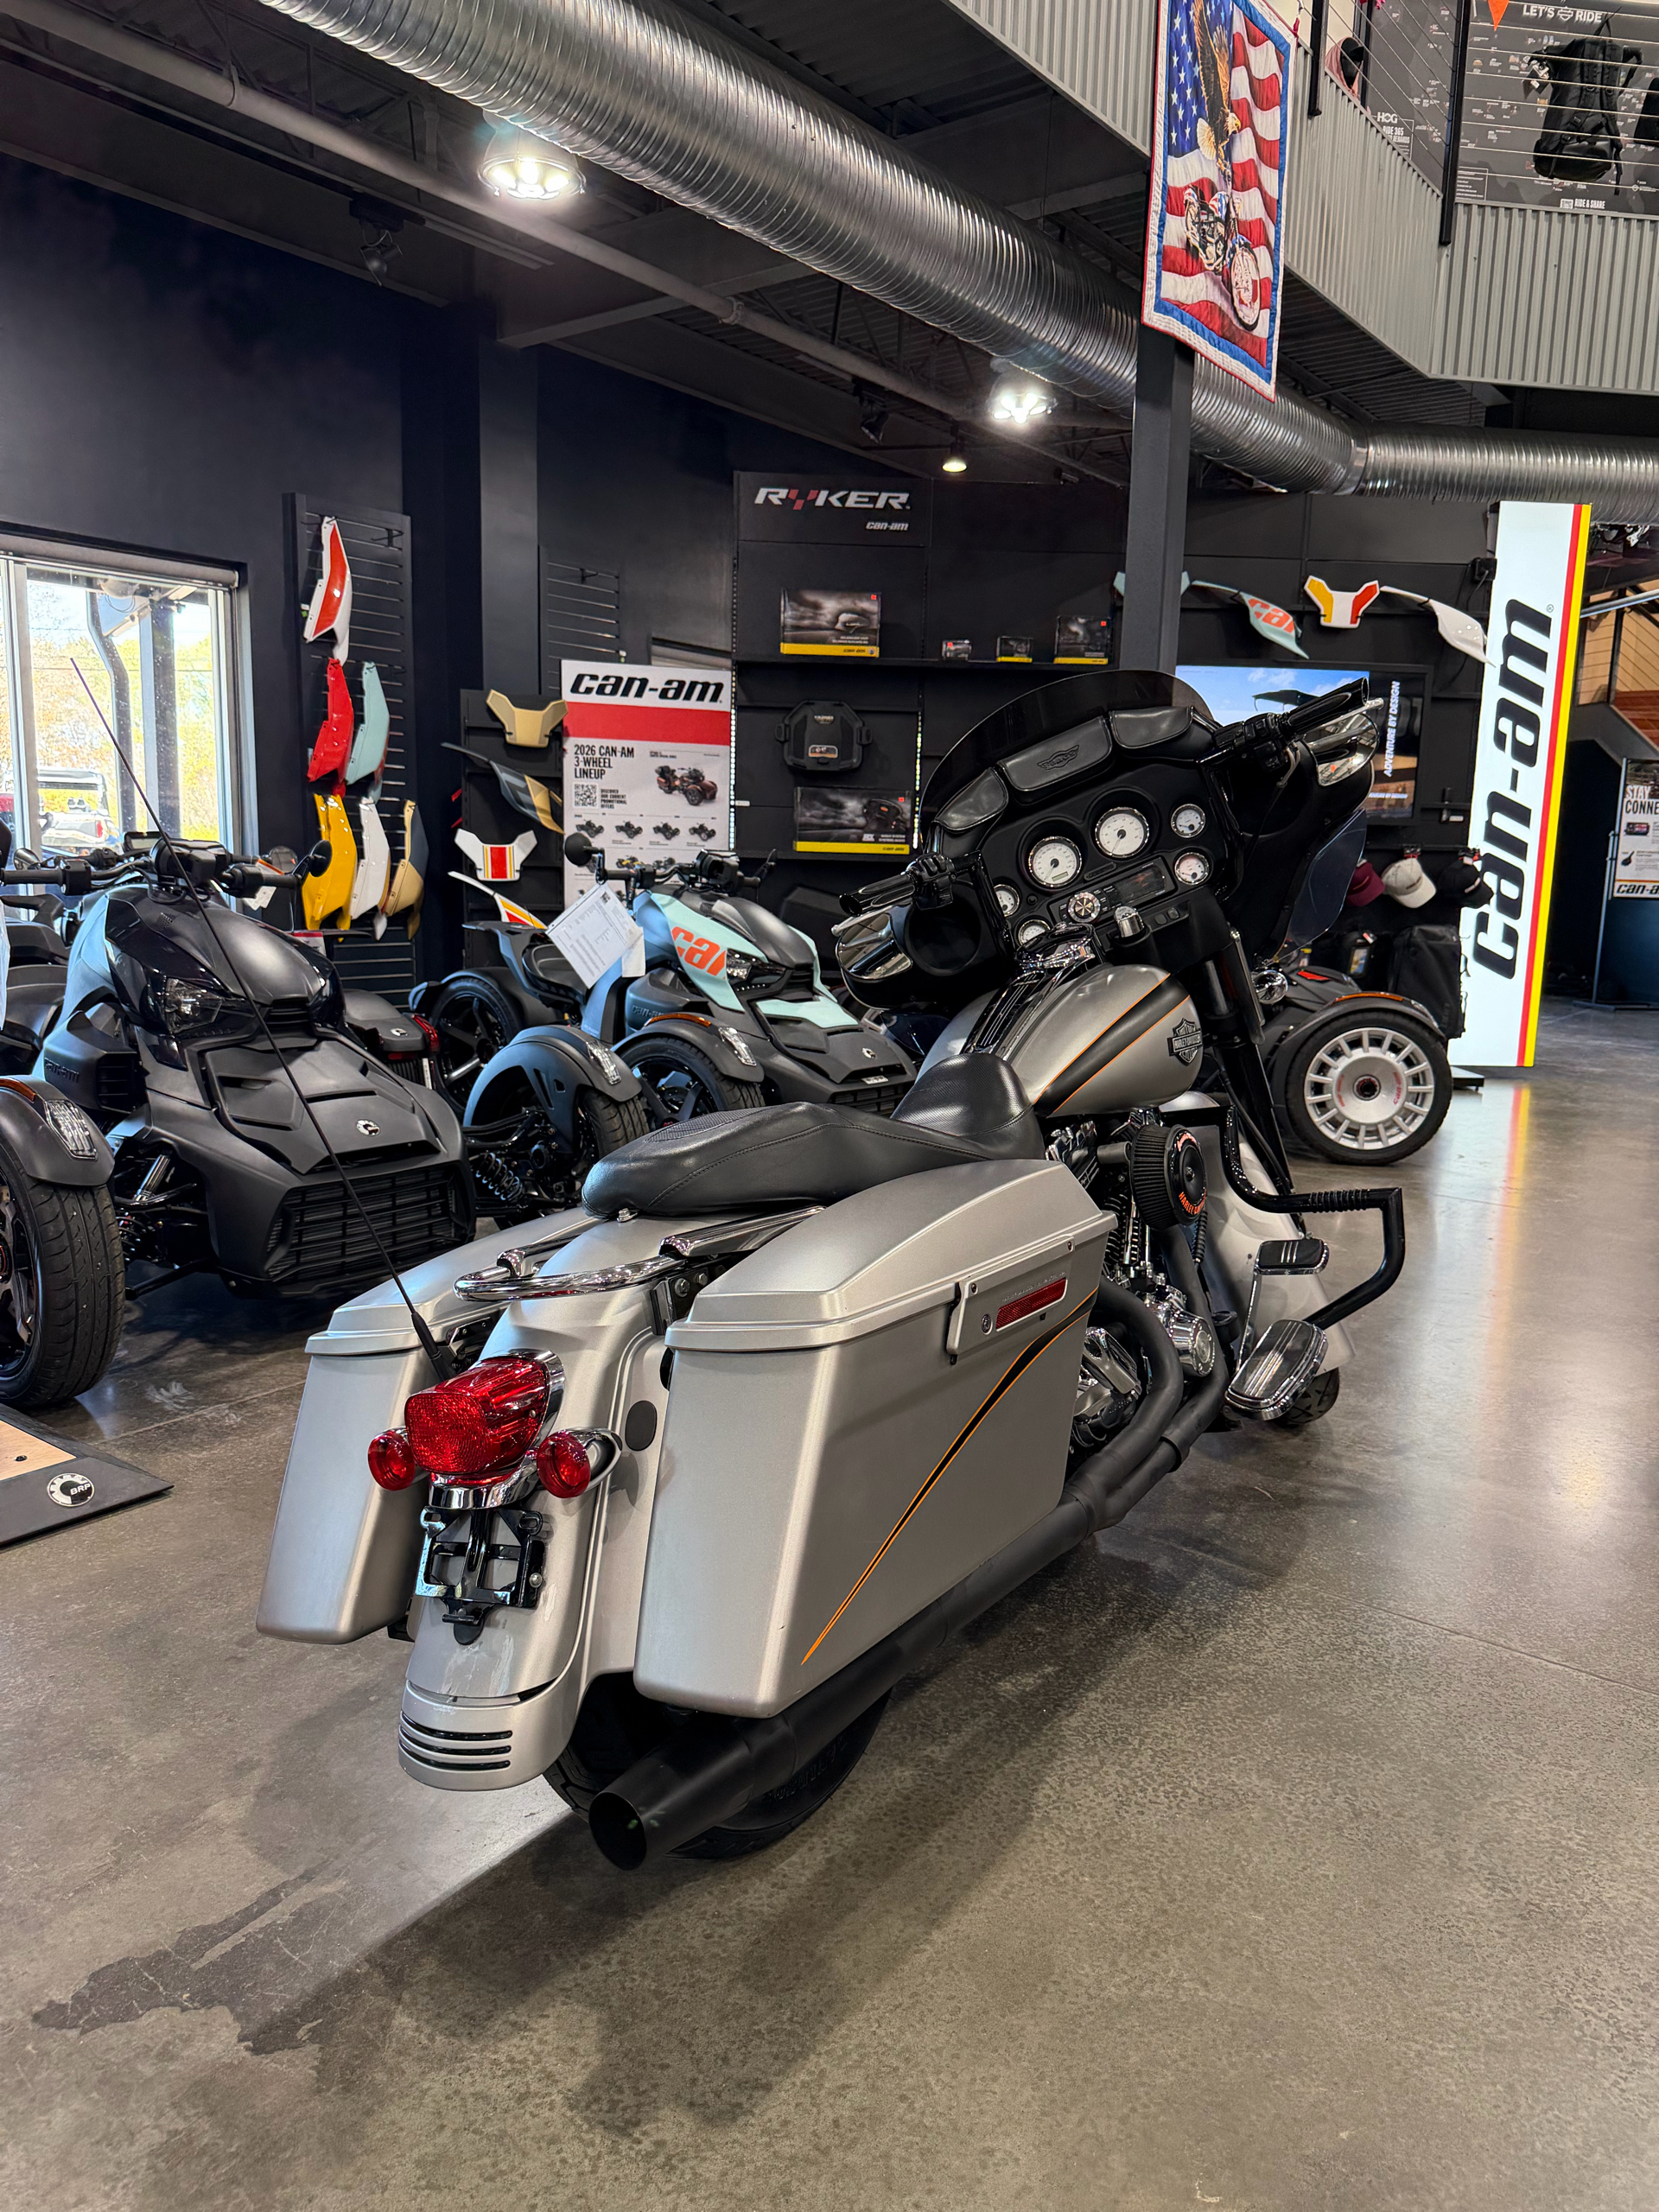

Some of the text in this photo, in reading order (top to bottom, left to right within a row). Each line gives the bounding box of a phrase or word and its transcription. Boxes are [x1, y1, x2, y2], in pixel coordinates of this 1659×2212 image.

[1522, 4, 1603, 22] LET'S RIDE
[1376, 111, 1398, 124] HOG
[1394, 127, 1404, 137] 365
[1574, 198, 1586, 207] RIDE
[1590, 200, 1605, 209] SHARE
[754, 487, 912, 511] RYKER
[866, 521, 909, 531] can-am
[569, 673, 725, 704] can-am
[1383, 681, 1401, 778] ADVENTURE BY DESIGN
[574, 744, 634, 759] 2026 CAN-AM
[574, 756, 613, 769] 3-WHEEL
[574, 767, 606, 780] LINEUP
[1472, 599, 1553, 980] can-am
[1625, 785, 1652, 799] STAY
[632, 1005, 665, 1019] can-a
[70, 1483, 91, 1496] BRP
